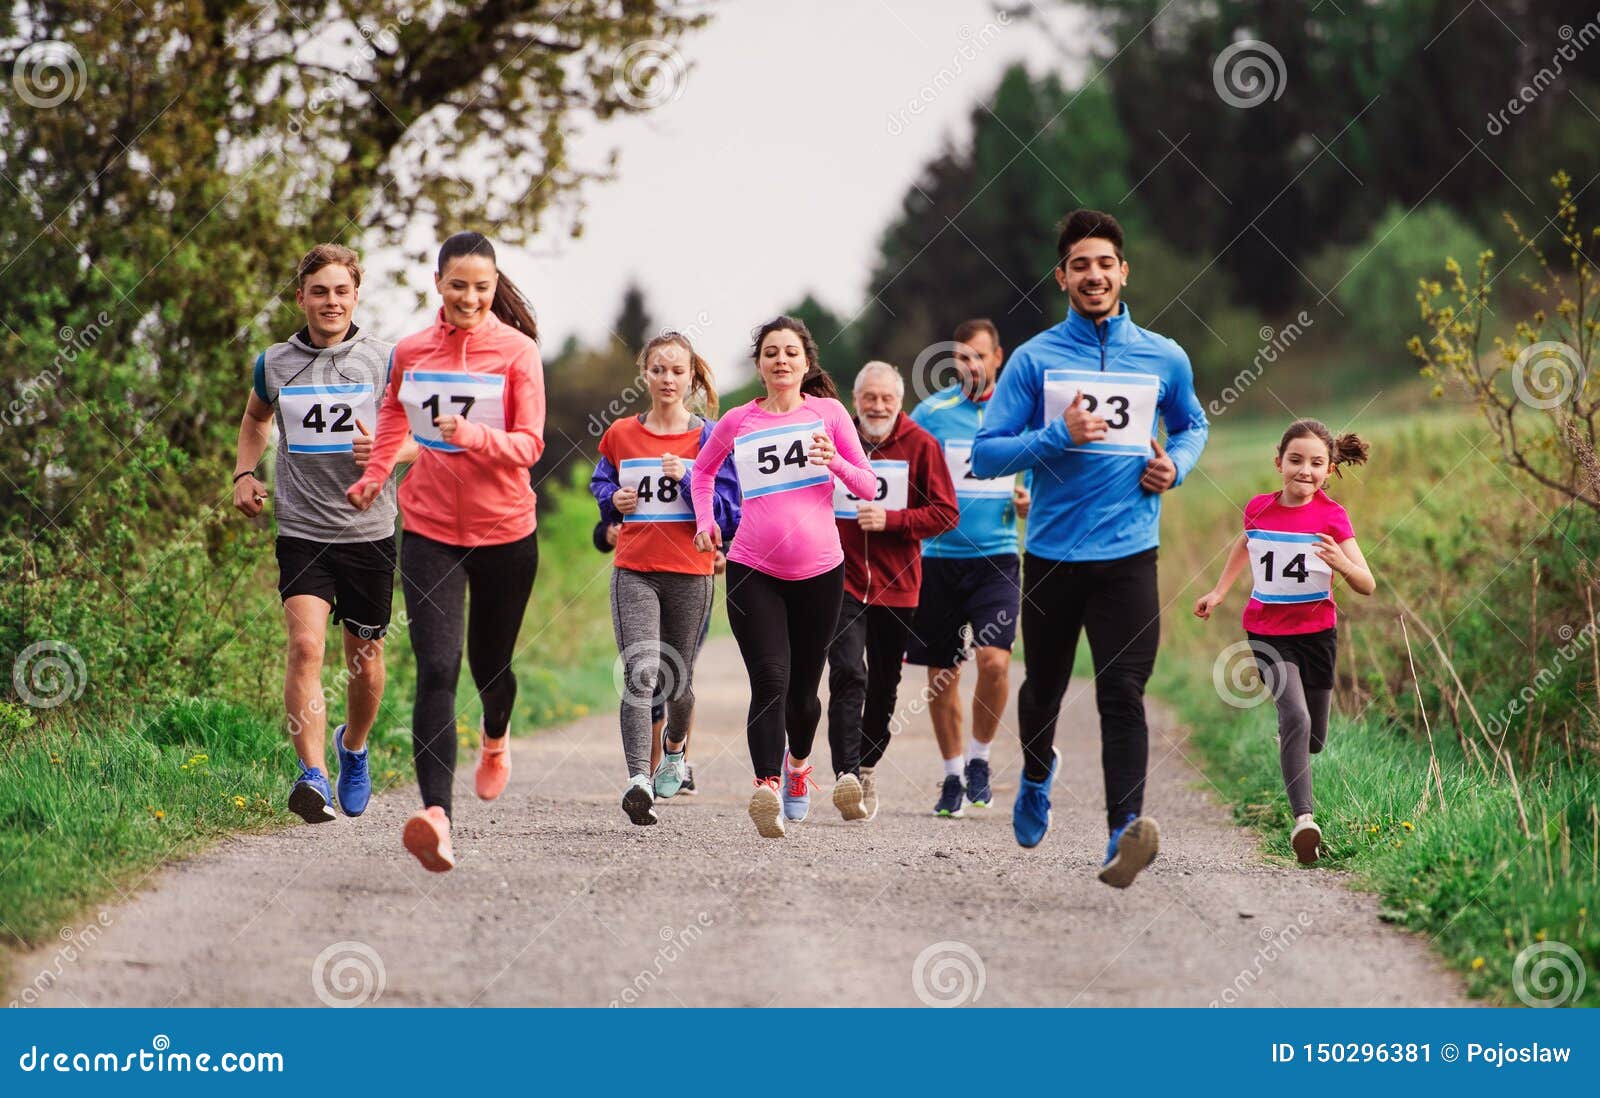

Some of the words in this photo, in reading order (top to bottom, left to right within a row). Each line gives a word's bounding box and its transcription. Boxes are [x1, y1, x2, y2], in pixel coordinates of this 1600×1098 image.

[302, 403, 354, 434] 42
[421, 393, 475, 428] 17
[757, 439, 808, 475] 54
[637, 475, 678, 503] 48
[1260, 550, 1309, 584] 14
